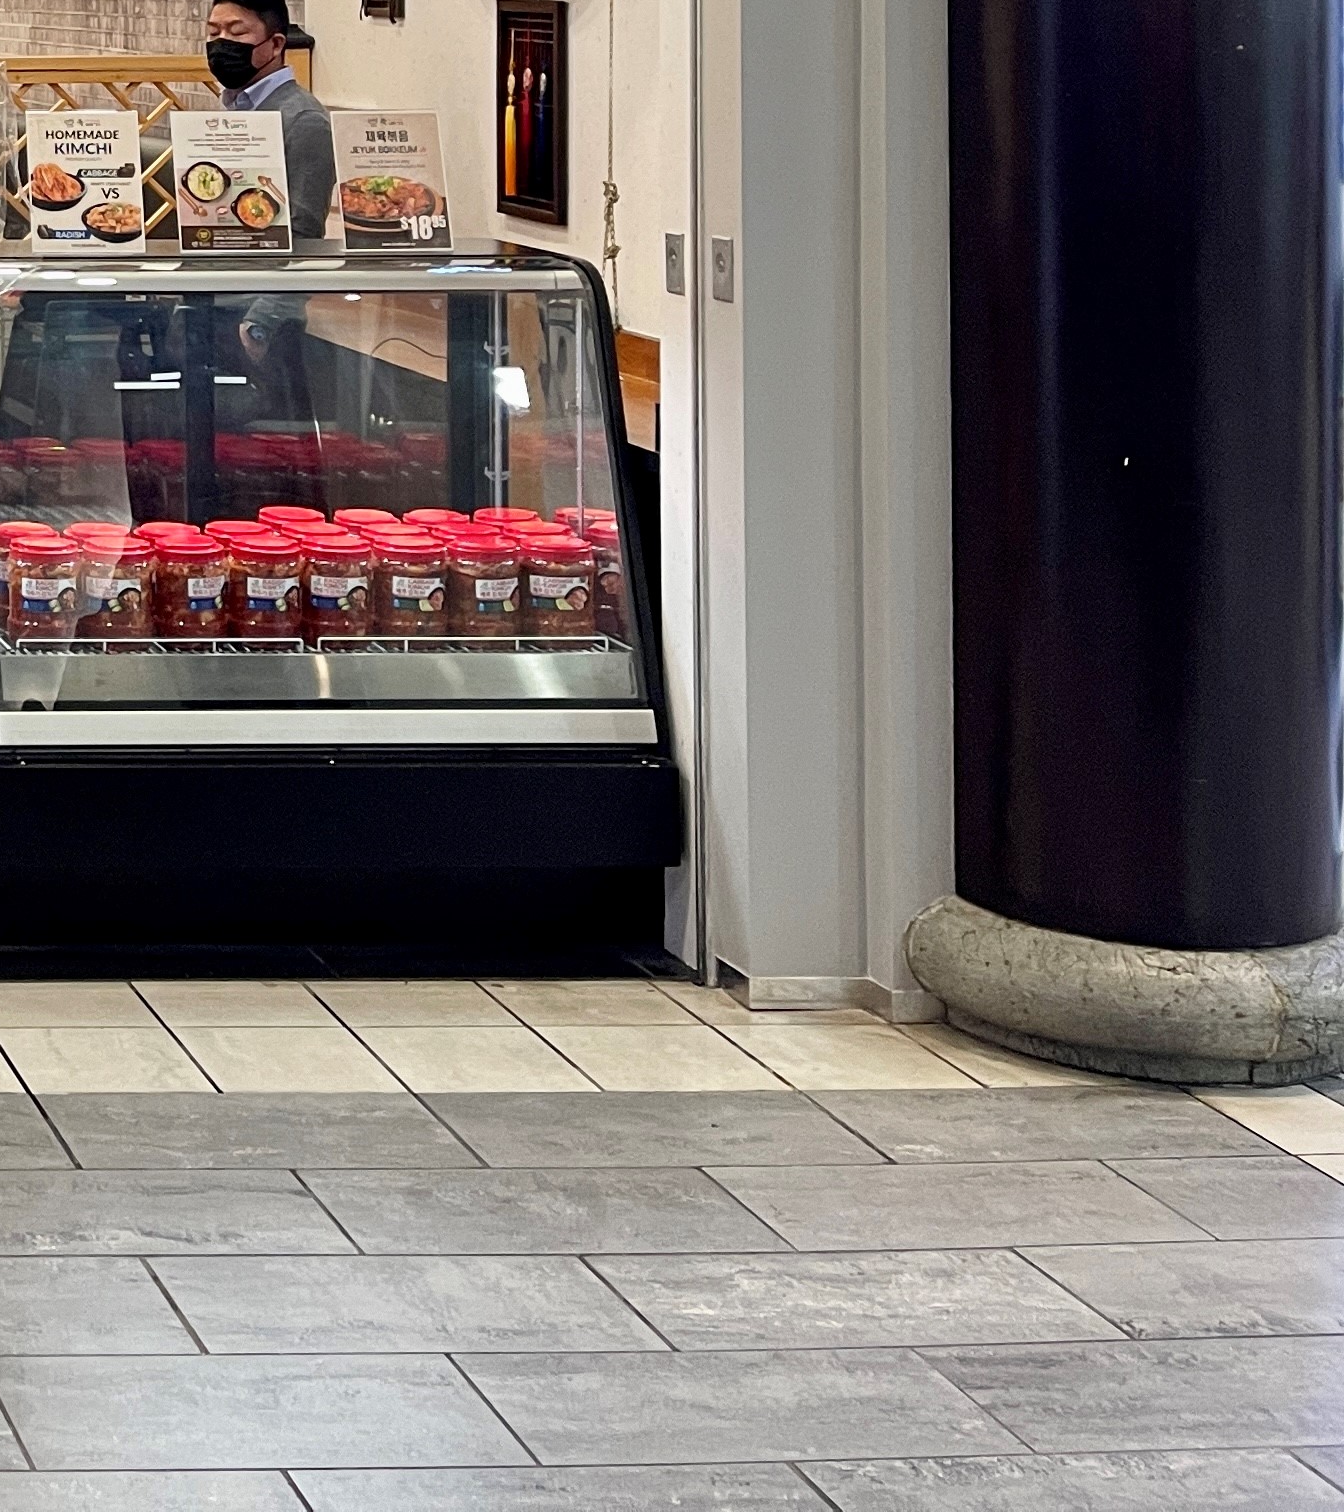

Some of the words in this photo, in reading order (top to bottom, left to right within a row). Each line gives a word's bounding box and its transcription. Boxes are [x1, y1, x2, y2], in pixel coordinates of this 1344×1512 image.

[45, 130, 120, 140] HOMEMADE
[54, 143, 112, 155] KIMCHI
[101, 188, 120, 199] VS
